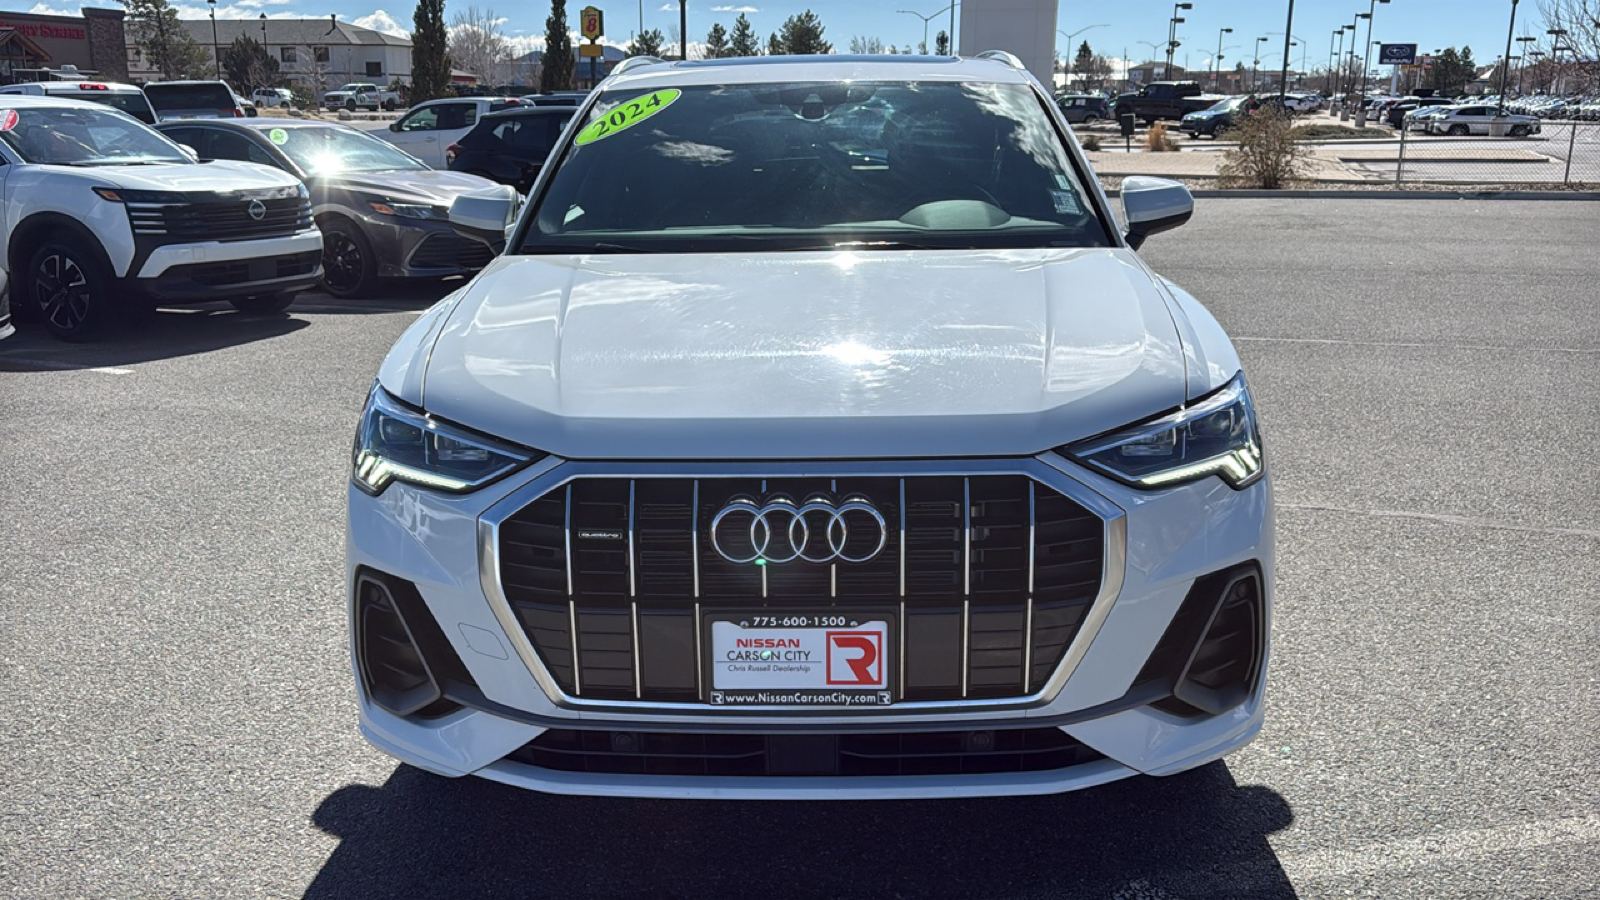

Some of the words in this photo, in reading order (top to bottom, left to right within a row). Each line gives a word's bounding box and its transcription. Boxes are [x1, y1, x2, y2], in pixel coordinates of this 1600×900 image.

[586, 17, 597, 32] 8
[592, 93, 662, 137] 2024
[736, 638, 800, 648] NISSAN
[726, 650, 780, 661] CARSON
[784, 650, 811, 661] CITY
[832, 636, 877, 683] R
[727, 664, 746, 672] Chris
[747, 664, 771, 672] Russell
[772, 664, 811, 674] Dealership
[725, 691, 876, 705] www.NissanCarsonCity.com
